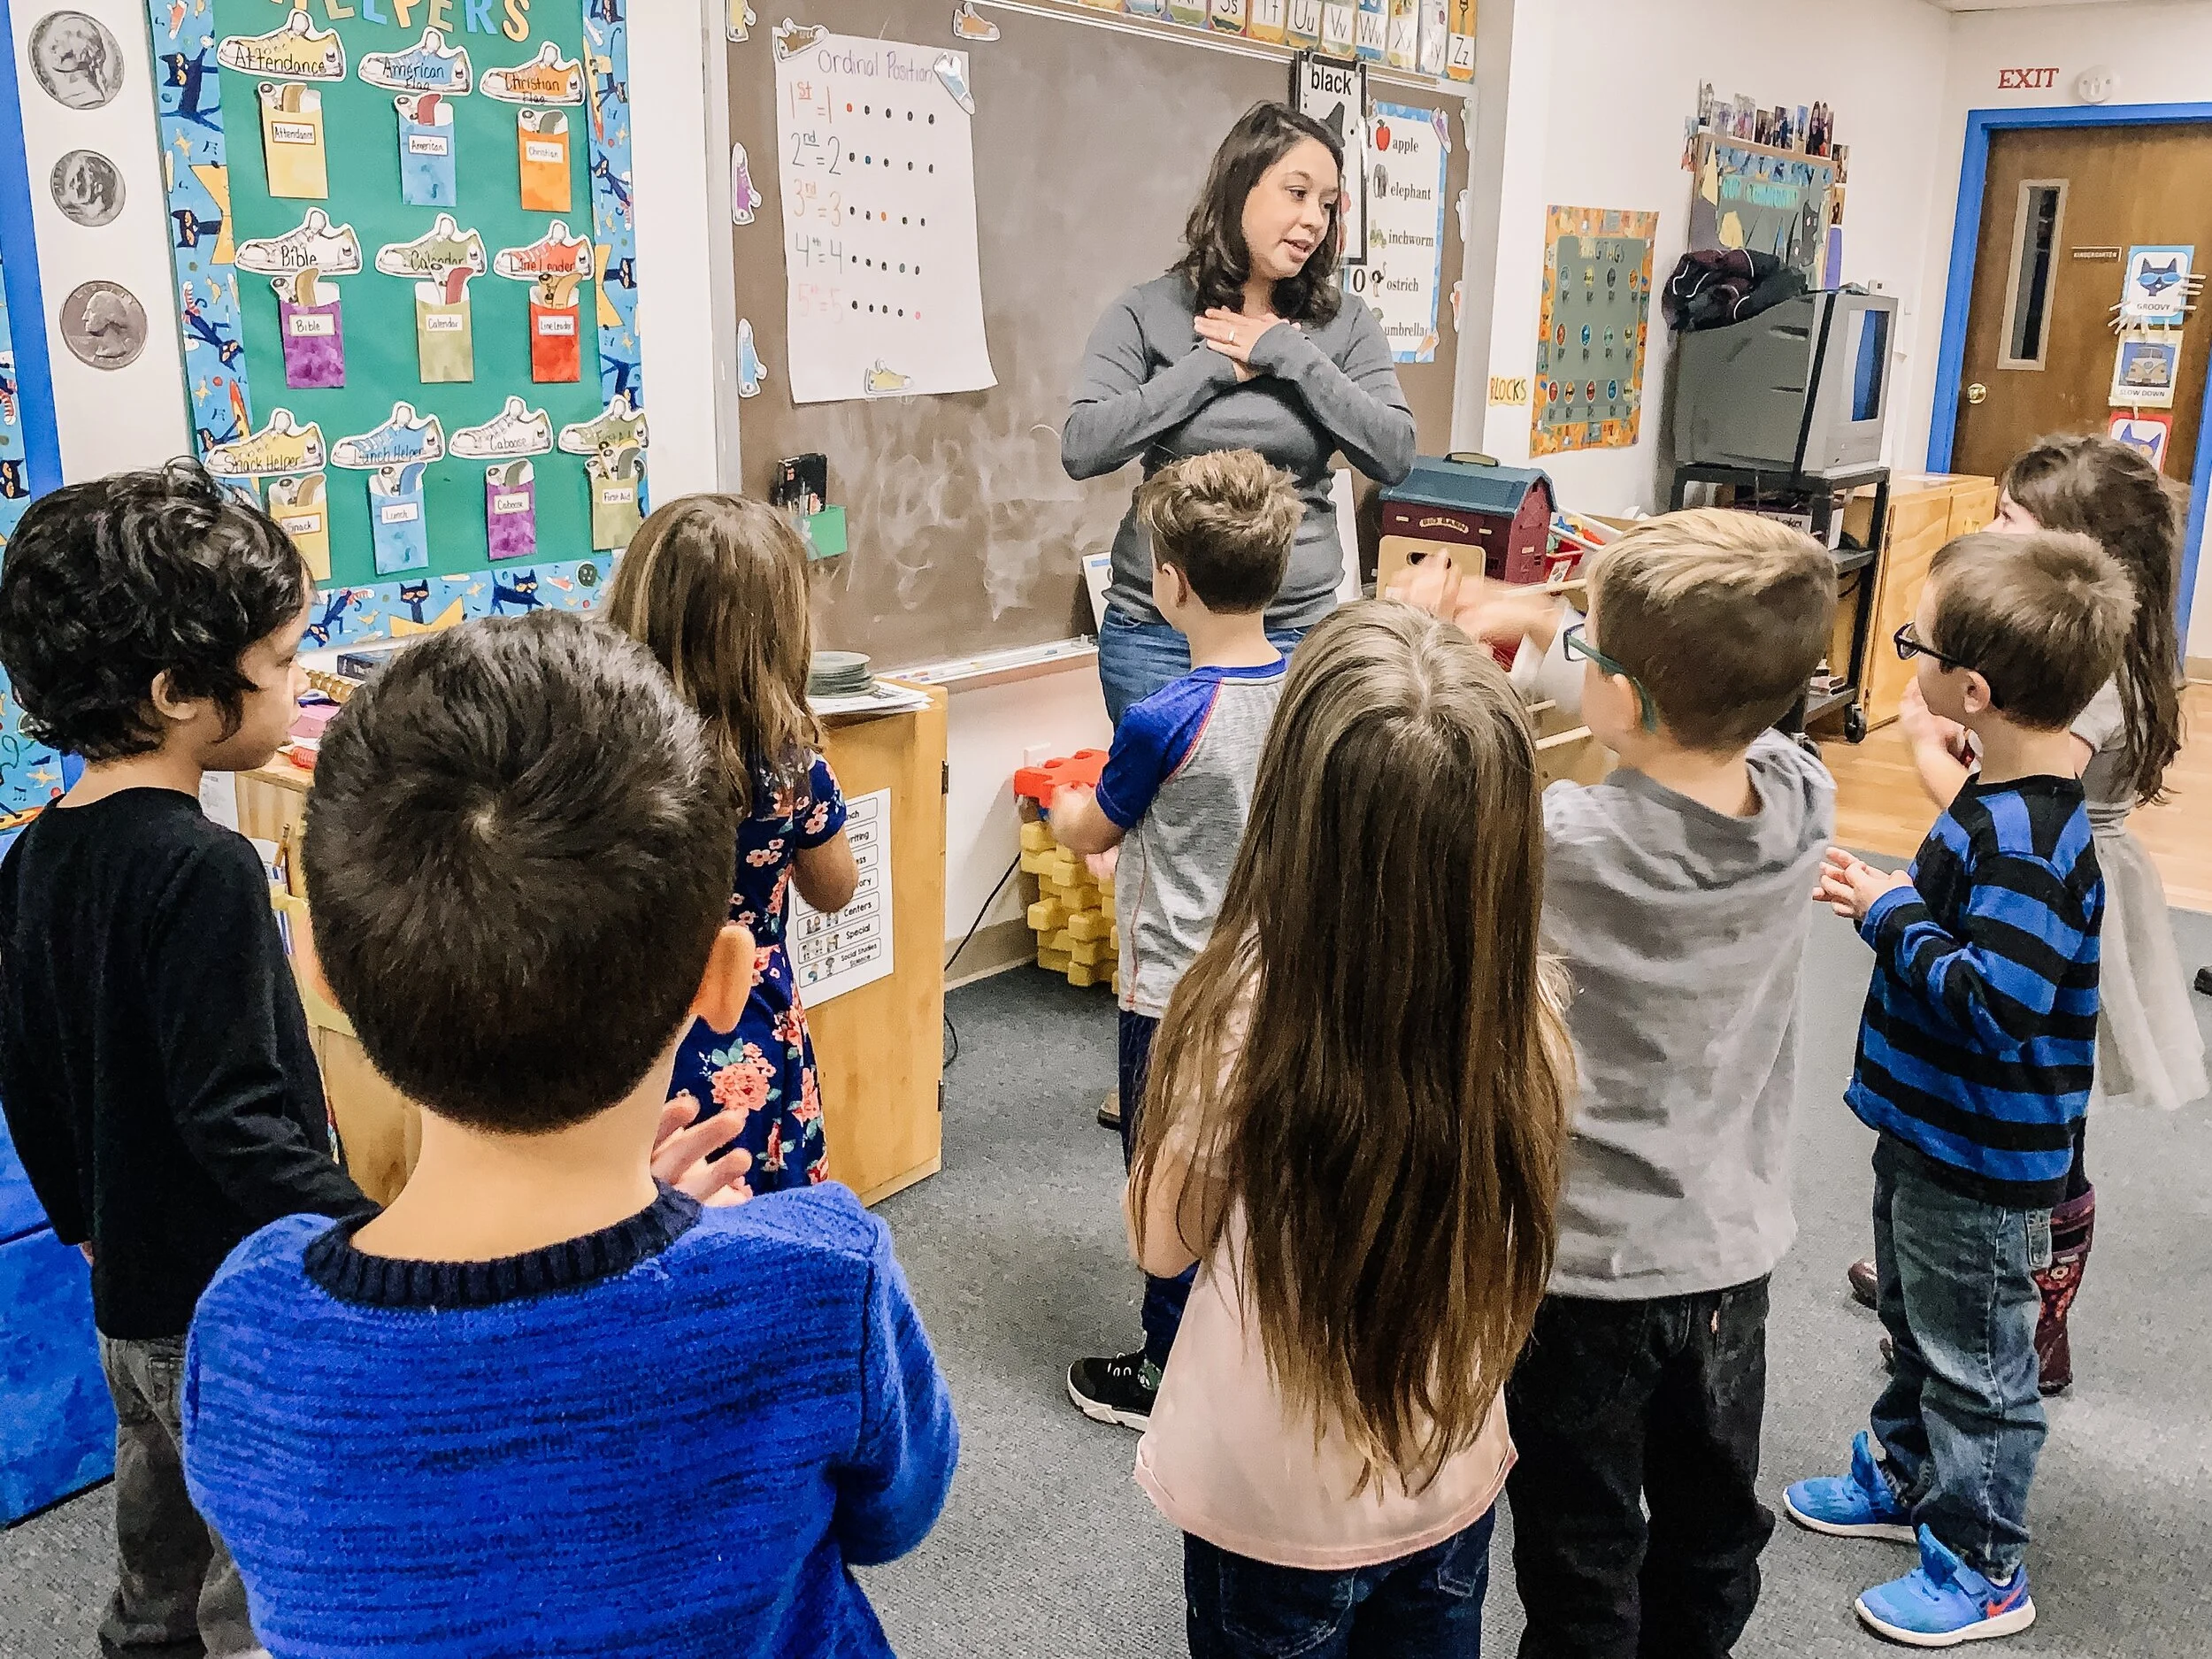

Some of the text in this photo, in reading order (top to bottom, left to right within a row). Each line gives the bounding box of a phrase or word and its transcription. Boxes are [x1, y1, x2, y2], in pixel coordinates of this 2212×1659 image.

[270, 0, 530, 42] LPERS
[1330, 7, 1347, 39] Vv
[1359, 12, 1385, 45] Ww
[1394, 20, 1414, 51] Xx
[1453, 36, 1469, 65] Zz
[234, 46, 326, 74] Attendance
[382, 57, 445, 79] American
[818, 49, 933, 84] Ordinal Position
[404, 75, 431, 92] Flag
[504, 73, 560, 92] Christian
[1310, 66, 1352, 96] black
[1997, 67, 2060, 89] EXIT
[274, 126, 314, 140] Attendance
[411, 139, 445, 152] American
[1392, 136, 1419, 154] apple
[1390, 181, 1432, 201] elephant
[1388, 229, 1434, 247] inchworm
[280, 245, 318, 267] Bible
[1386, 277, 1419, 292] ostrich
[296, 319, 320, 332] Bible
[428, 318, 459, 329] Calendar
[1490, 377, 1527, 402] BLOCKS
[489, 434, 527, 450] Caboose
[223, 454, 302, 473] Snack Helper
[354, 445, 424, 465] Lunch Helper
[385, 510, 409, 520] Lunch
[287, 520, 312, 531] Snack
[843, 902, 872, 918] Centers
[846, 923, 871, 940] Special
[841, 942, 878, 962] Social Studies
